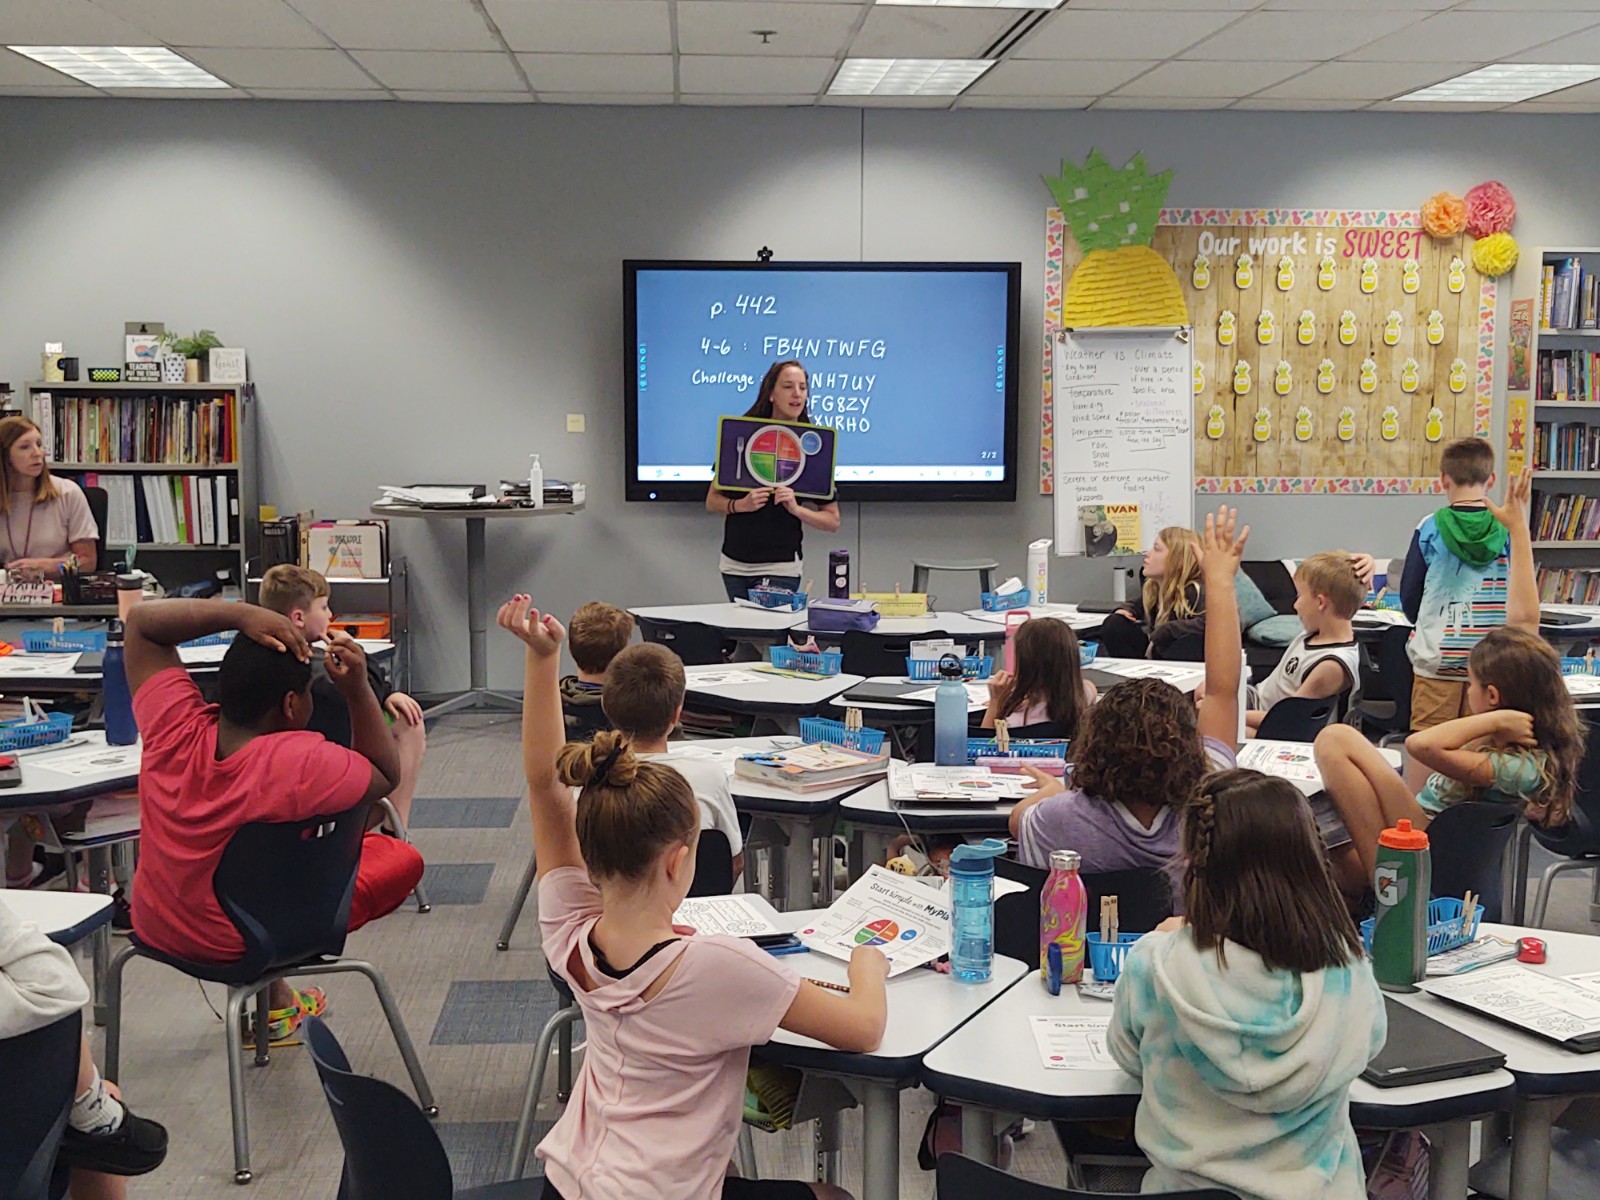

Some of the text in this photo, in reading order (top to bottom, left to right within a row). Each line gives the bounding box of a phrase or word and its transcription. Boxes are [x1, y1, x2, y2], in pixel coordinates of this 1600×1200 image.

[1199, 229, 1426, 260] Our work is SWEET
[710, 294, 777, 319] p. 442
[1064, 350, 1105, 361] Weather
[1134, 349, 1173, 360] Climate
[692, 369, 754, 392] Challenge
[811, 373, 876, 391] NH7UY
[808, 414, 871, 433] XVRHO
[981, 450, 997, 459] 2/2
[1106, 505, 1138, 514] IVAN
[1037, 562, 1046, 605] adidas
[1375, 866, 1399, 906] G
[870, 882, 890, 897] Start
[889, 889, 913, 907] simple
[923, 903, 949, 921] MyPla
